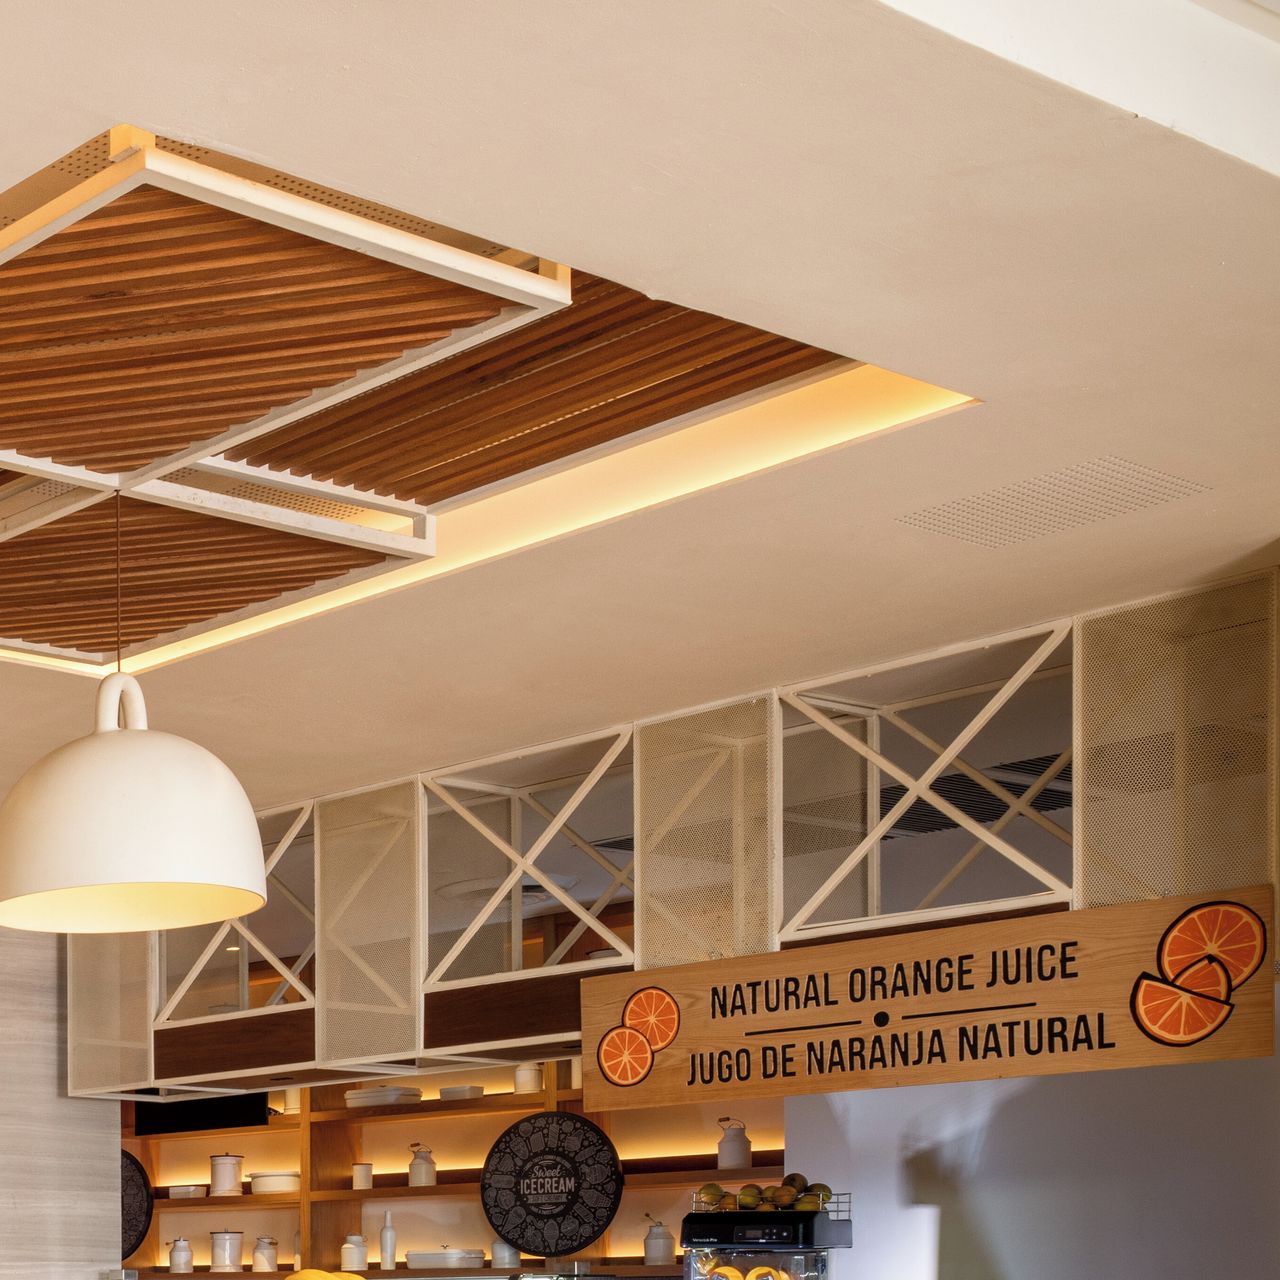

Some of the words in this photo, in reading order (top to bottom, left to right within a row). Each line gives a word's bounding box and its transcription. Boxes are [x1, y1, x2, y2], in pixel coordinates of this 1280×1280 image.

[710, 972, 839, 1019] NATURAL
[848, 953, 975, 1003] ORANGE
[986, 940, 1079, 988] JUICE
[686, 1048, 752, 1086] JUGO
[761, 1043, 797, 1079] DE
[806, 1028, 947, 1075] NARANJA
[958, 1012, 1116, 1062] NATURAL
[520, 1177, 575, 1194] ICECREAM
[531, 1164, 562, 1178] Sweet
